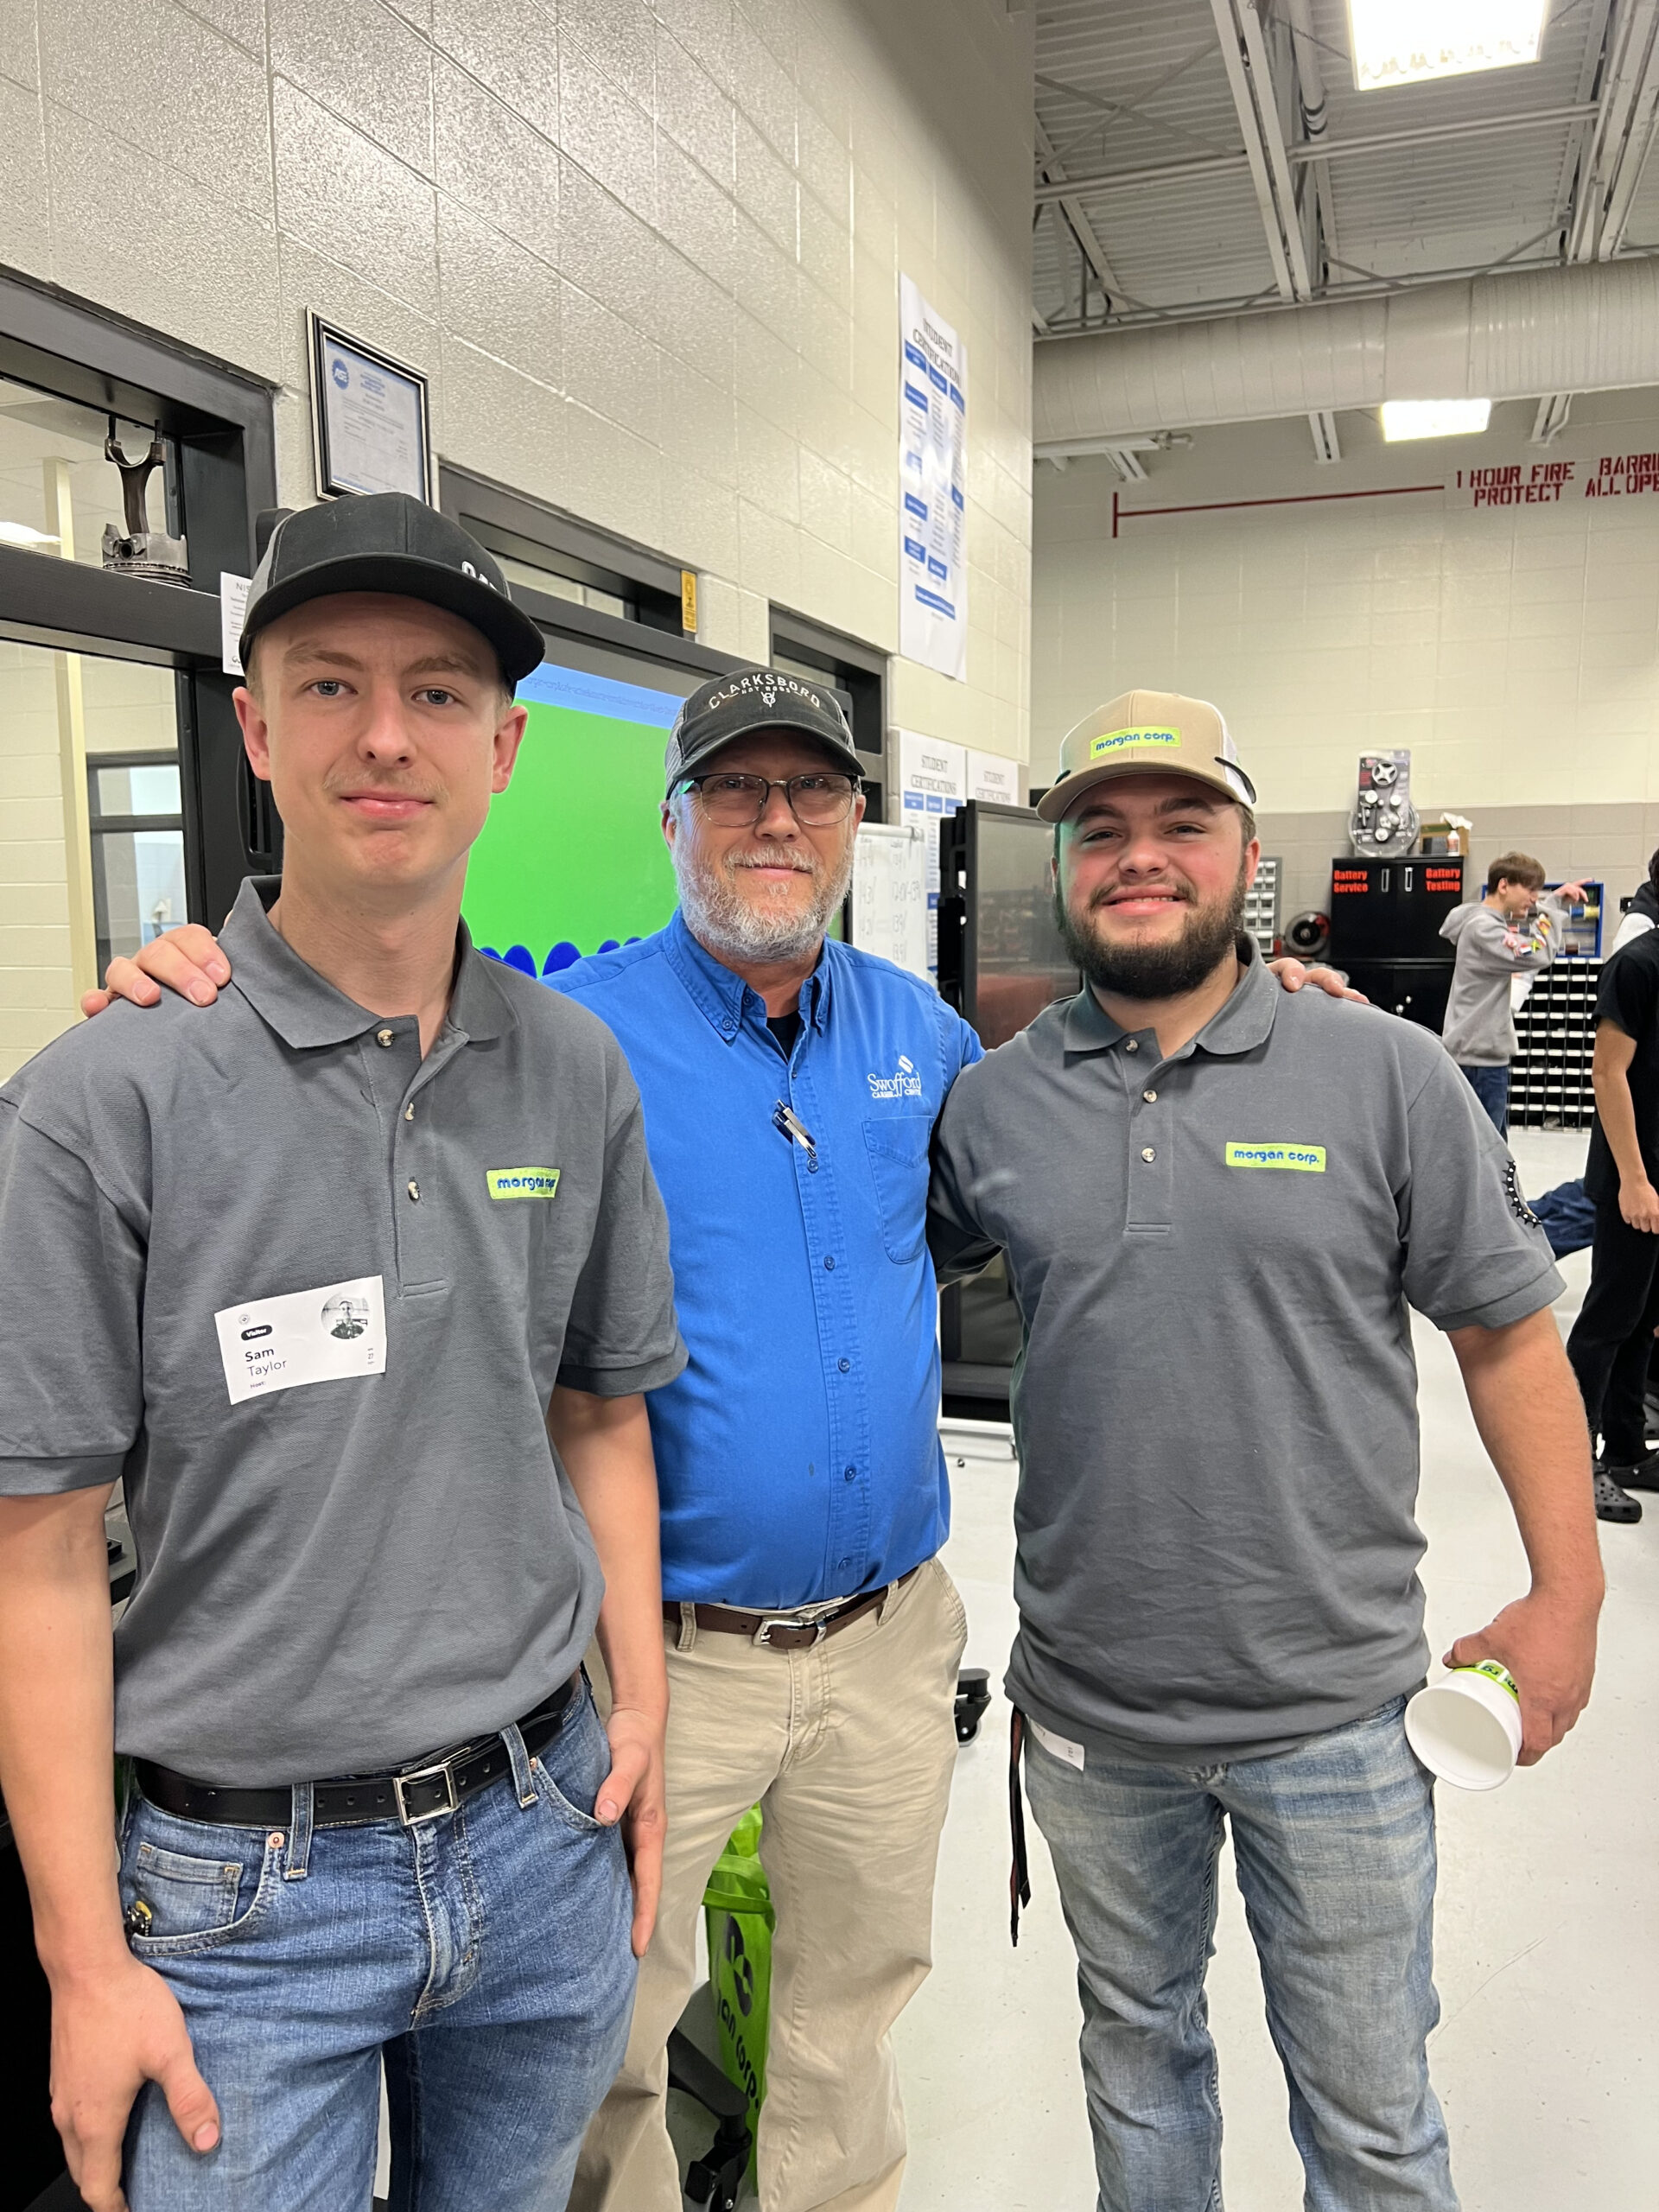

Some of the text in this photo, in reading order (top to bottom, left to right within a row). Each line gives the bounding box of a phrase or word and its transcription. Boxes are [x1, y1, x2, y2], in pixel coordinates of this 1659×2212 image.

[1457, 453, 1659, 489] 1 HOUR FIRE BARRI
[1474, 482, 1563, 507] PROTECT
[1585, 477, 1621, 498] ALL
[709, 674, 820, 709] CLARKSBORO
[1096, 733, 1175, 750] morgan corp.
[922, 754, 948, 772] STUDENT
[1334, 870, 1368, 881] Battery
[1426, 868, 1460, 880] Battery
[1333, 882, 1369, 893] Service
[1426, 880, 1460, 892] Testing
[867, 1071, 921, 1097] Swofford
[1234, 1150, 1319, 1165] morgan corp.
[245, 1349, 274, 1362] Sam
[247, 1361, 287, 1376] Taylor
[735, 2034, 760, 2109] corp.
